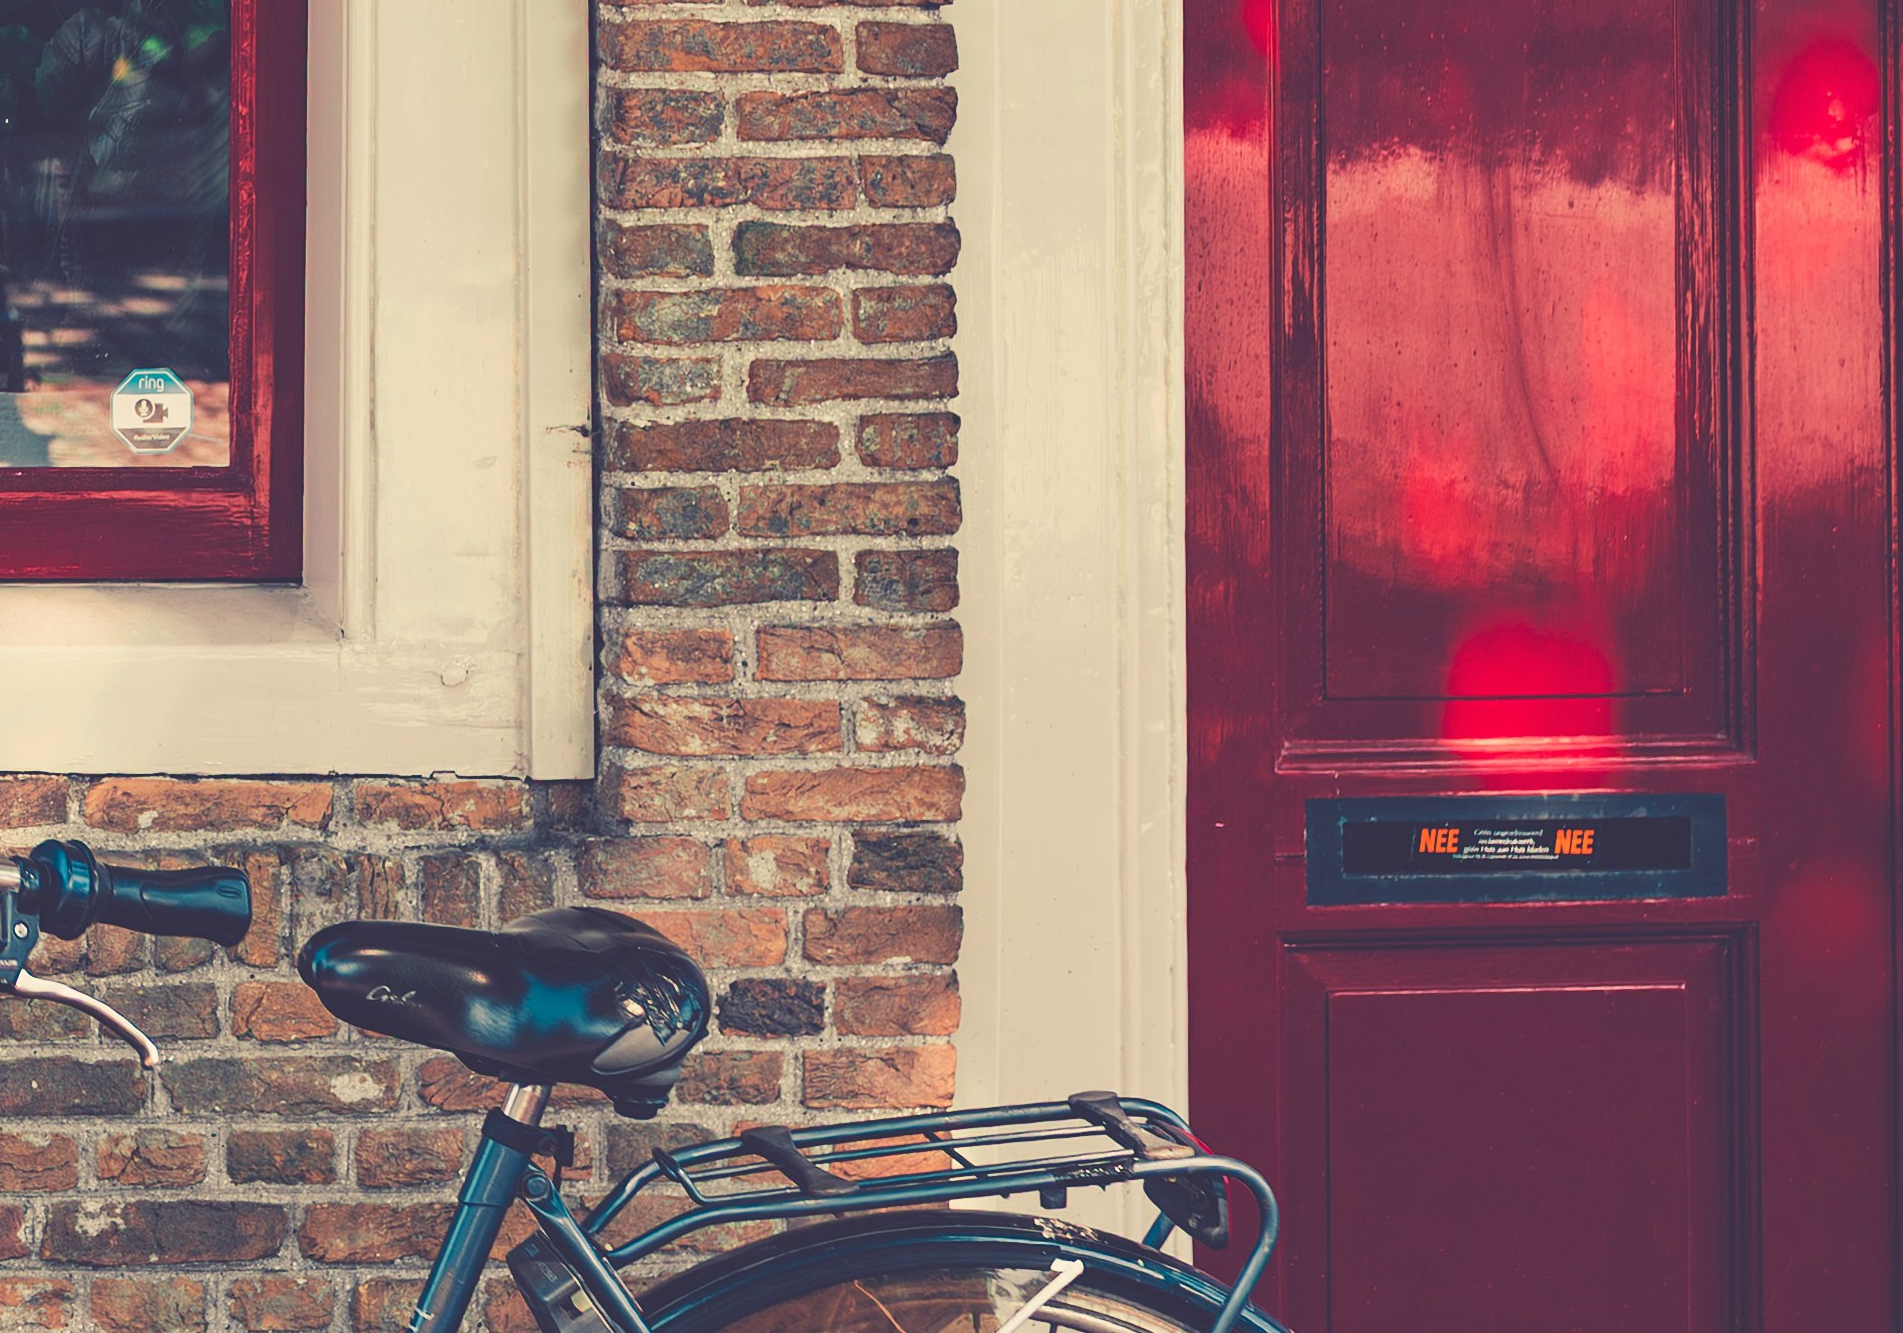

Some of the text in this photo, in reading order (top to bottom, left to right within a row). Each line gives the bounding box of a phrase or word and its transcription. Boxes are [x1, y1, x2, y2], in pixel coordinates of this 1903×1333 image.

[137, 374, 165, 393] ring
[1419, 828, 1460, 854] NEE
[1554, 829, 1595, 856] NEE
